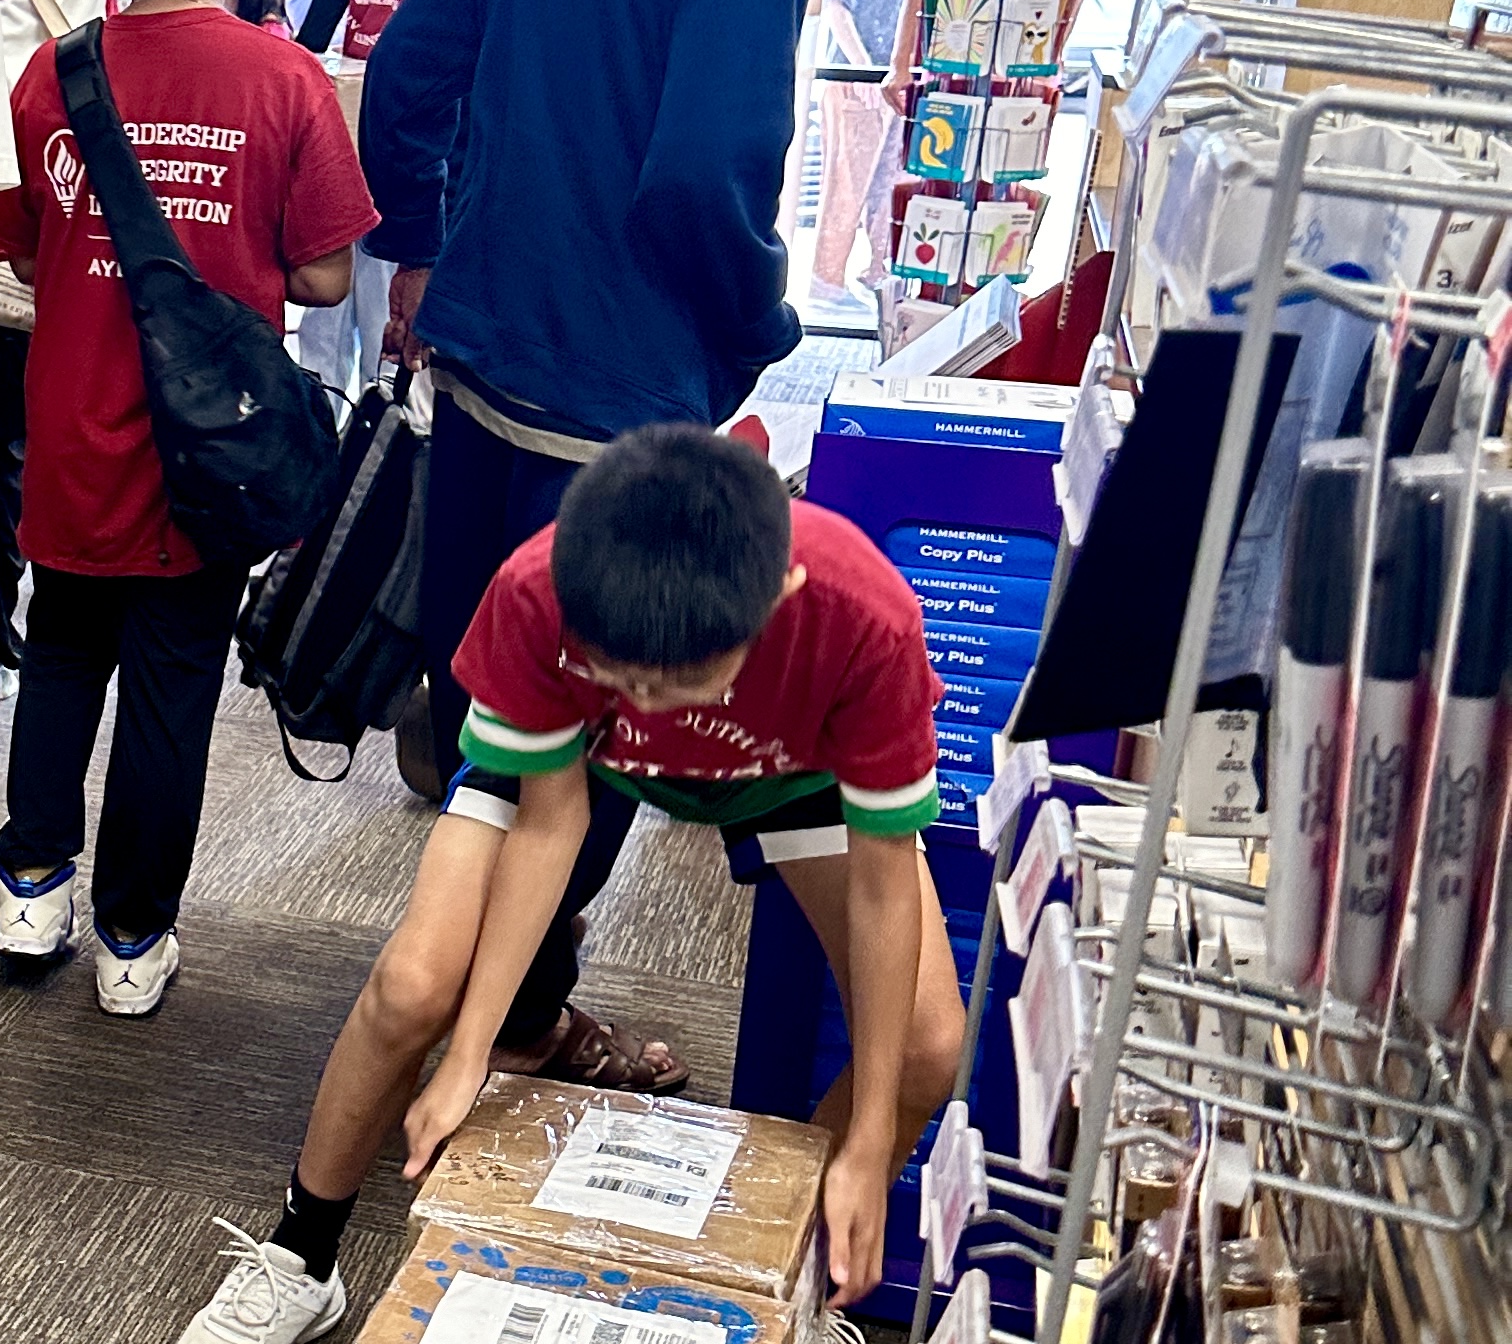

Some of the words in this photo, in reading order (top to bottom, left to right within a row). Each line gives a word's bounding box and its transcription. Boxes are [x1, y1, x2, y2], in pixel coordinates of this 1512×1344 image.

[122, 122, 246, 153] ADERSHIP
[141, 159, 228, 188] EGRITY
[935, 423, 1026, 438] HAMMERMILL
[919, 527, 1010, 544] HAMMERMILL
[919, 545, 963, 562] Copy
[911, 577, 1001, 594] HAMMERMILL
[916, 594, 955, 612] Copy
